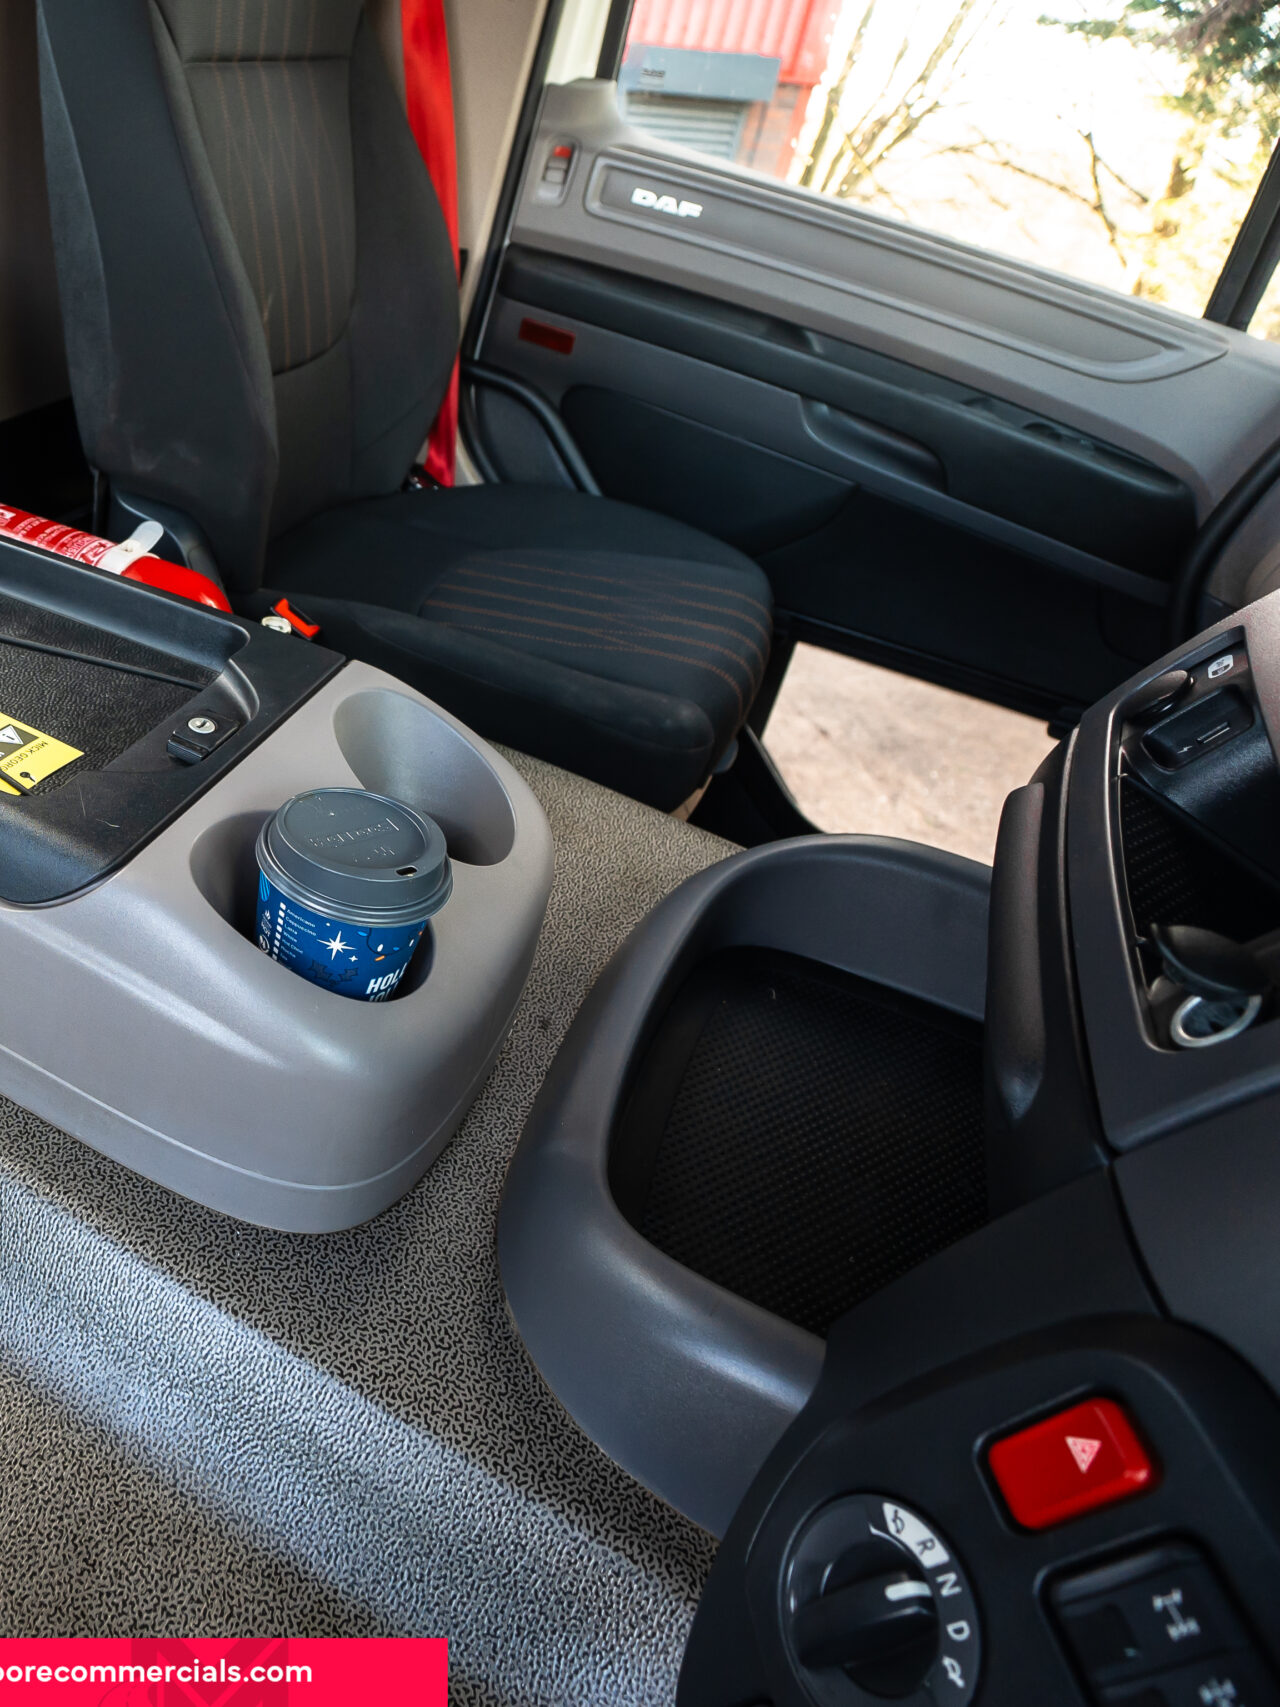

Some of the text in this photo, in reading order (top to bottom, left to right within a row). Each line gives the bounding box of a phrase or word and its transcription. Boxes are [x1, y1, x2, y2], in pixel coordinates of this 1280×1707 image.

[630, 187, 704, 218] DAF
[917, 1538, 936, 1555] R
[935, 1572, 962, 1597] N
[946, 1620, 970, 1642] D
